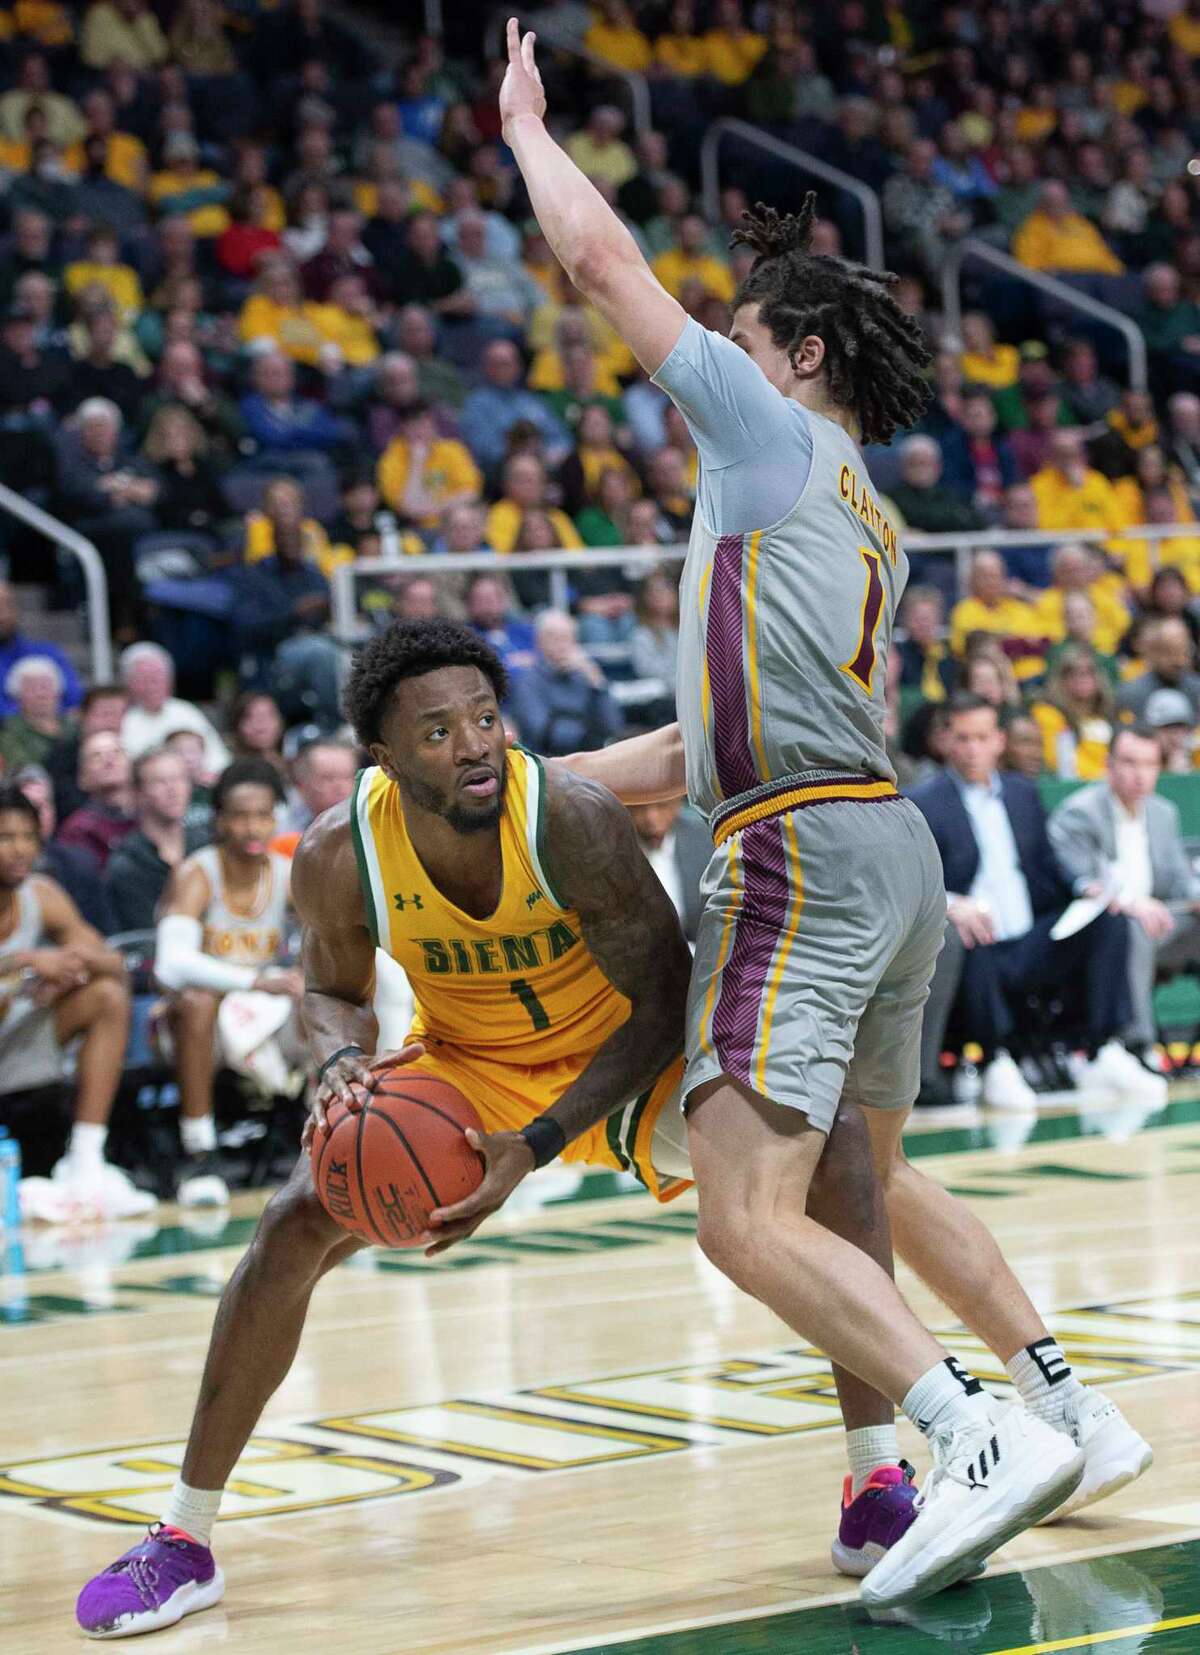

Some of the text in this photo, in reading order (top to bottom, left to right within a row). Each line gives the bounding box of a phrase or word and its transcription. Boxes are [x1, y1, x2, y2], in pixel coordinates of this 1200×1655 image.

[839, 463, 898, 568] CLAYTON
[838, 546, 886, 697] 1
[410, 918, 583, 976] SIENA
[510, 978, 550, 1031] 1
